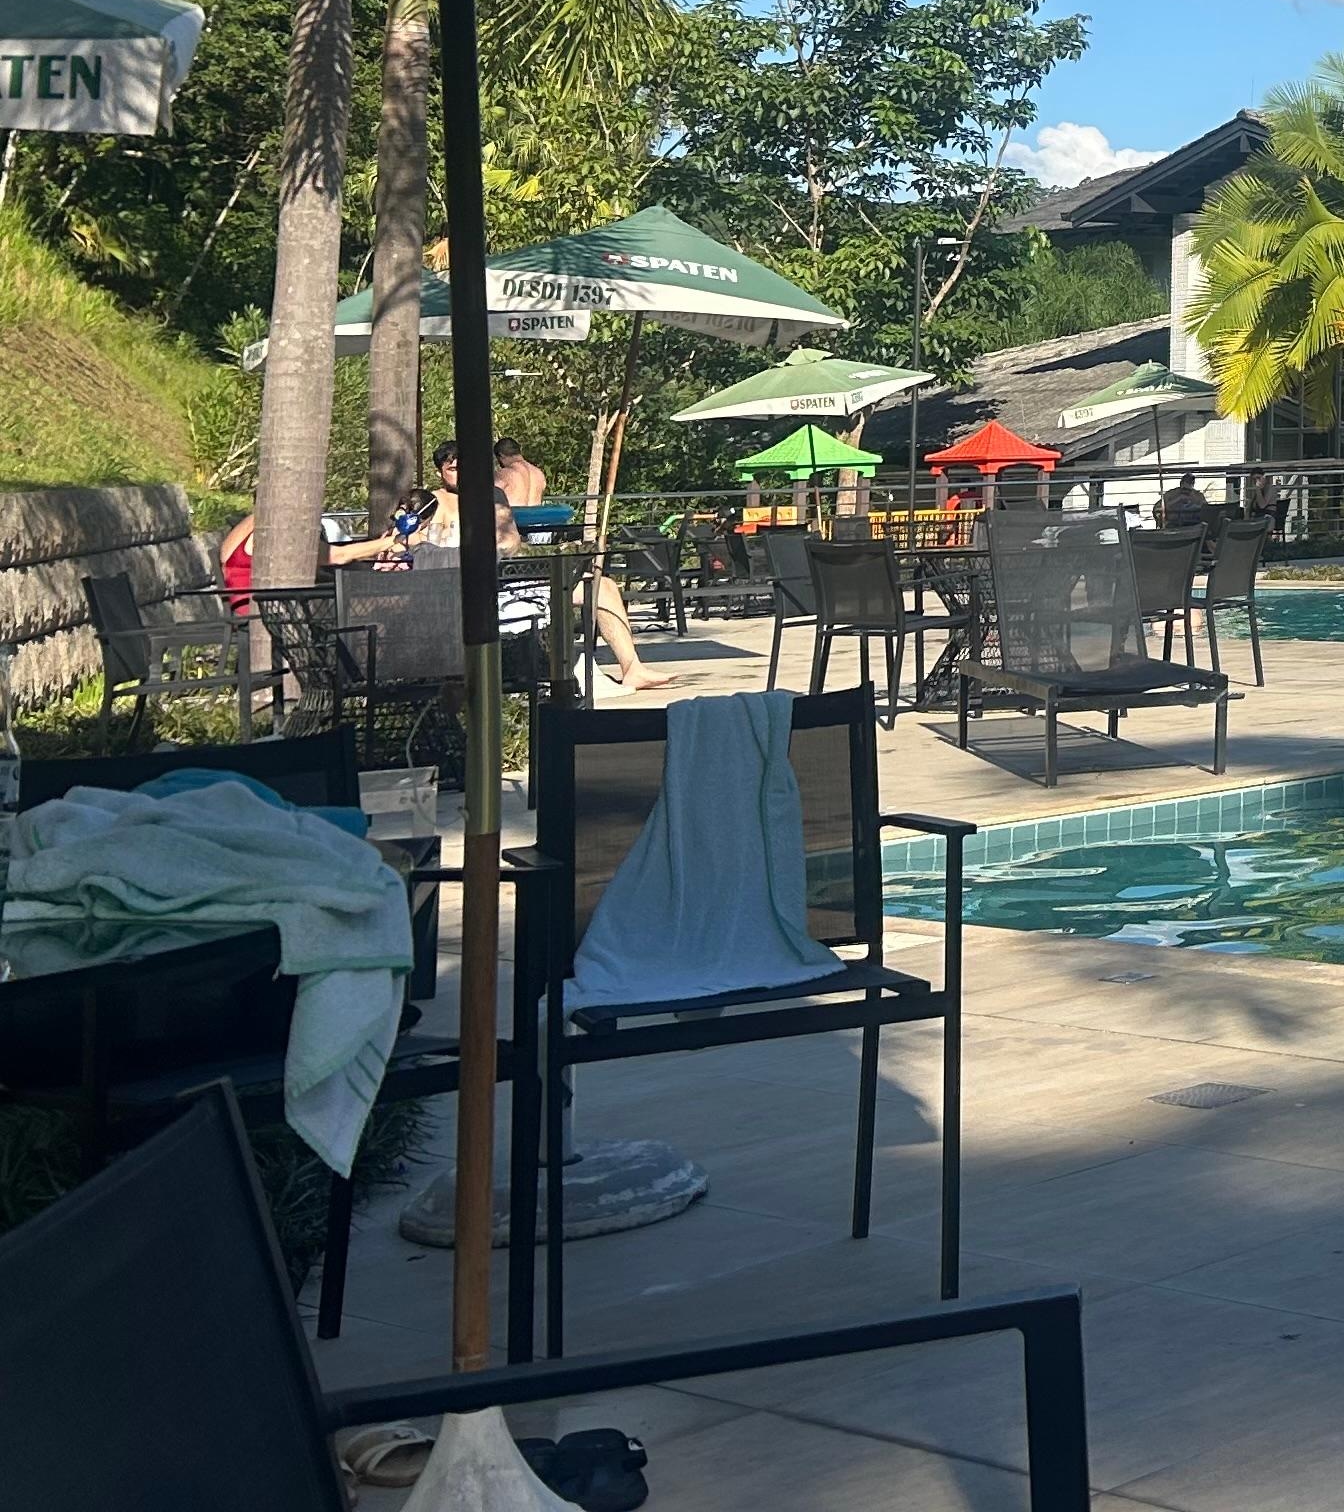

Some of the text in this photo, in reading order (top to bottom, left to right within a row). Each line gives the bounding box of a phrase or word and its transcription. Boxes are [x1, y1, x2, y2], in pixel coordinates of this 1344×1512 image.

[0, 54, 102, 101] TEN
[629, 254, 739, 284] SPATEN
[572, 284, 616, 306] 1397
[521, 315, 575, 331] SPATEN
[800, 396, 836, 410] SPATEN
